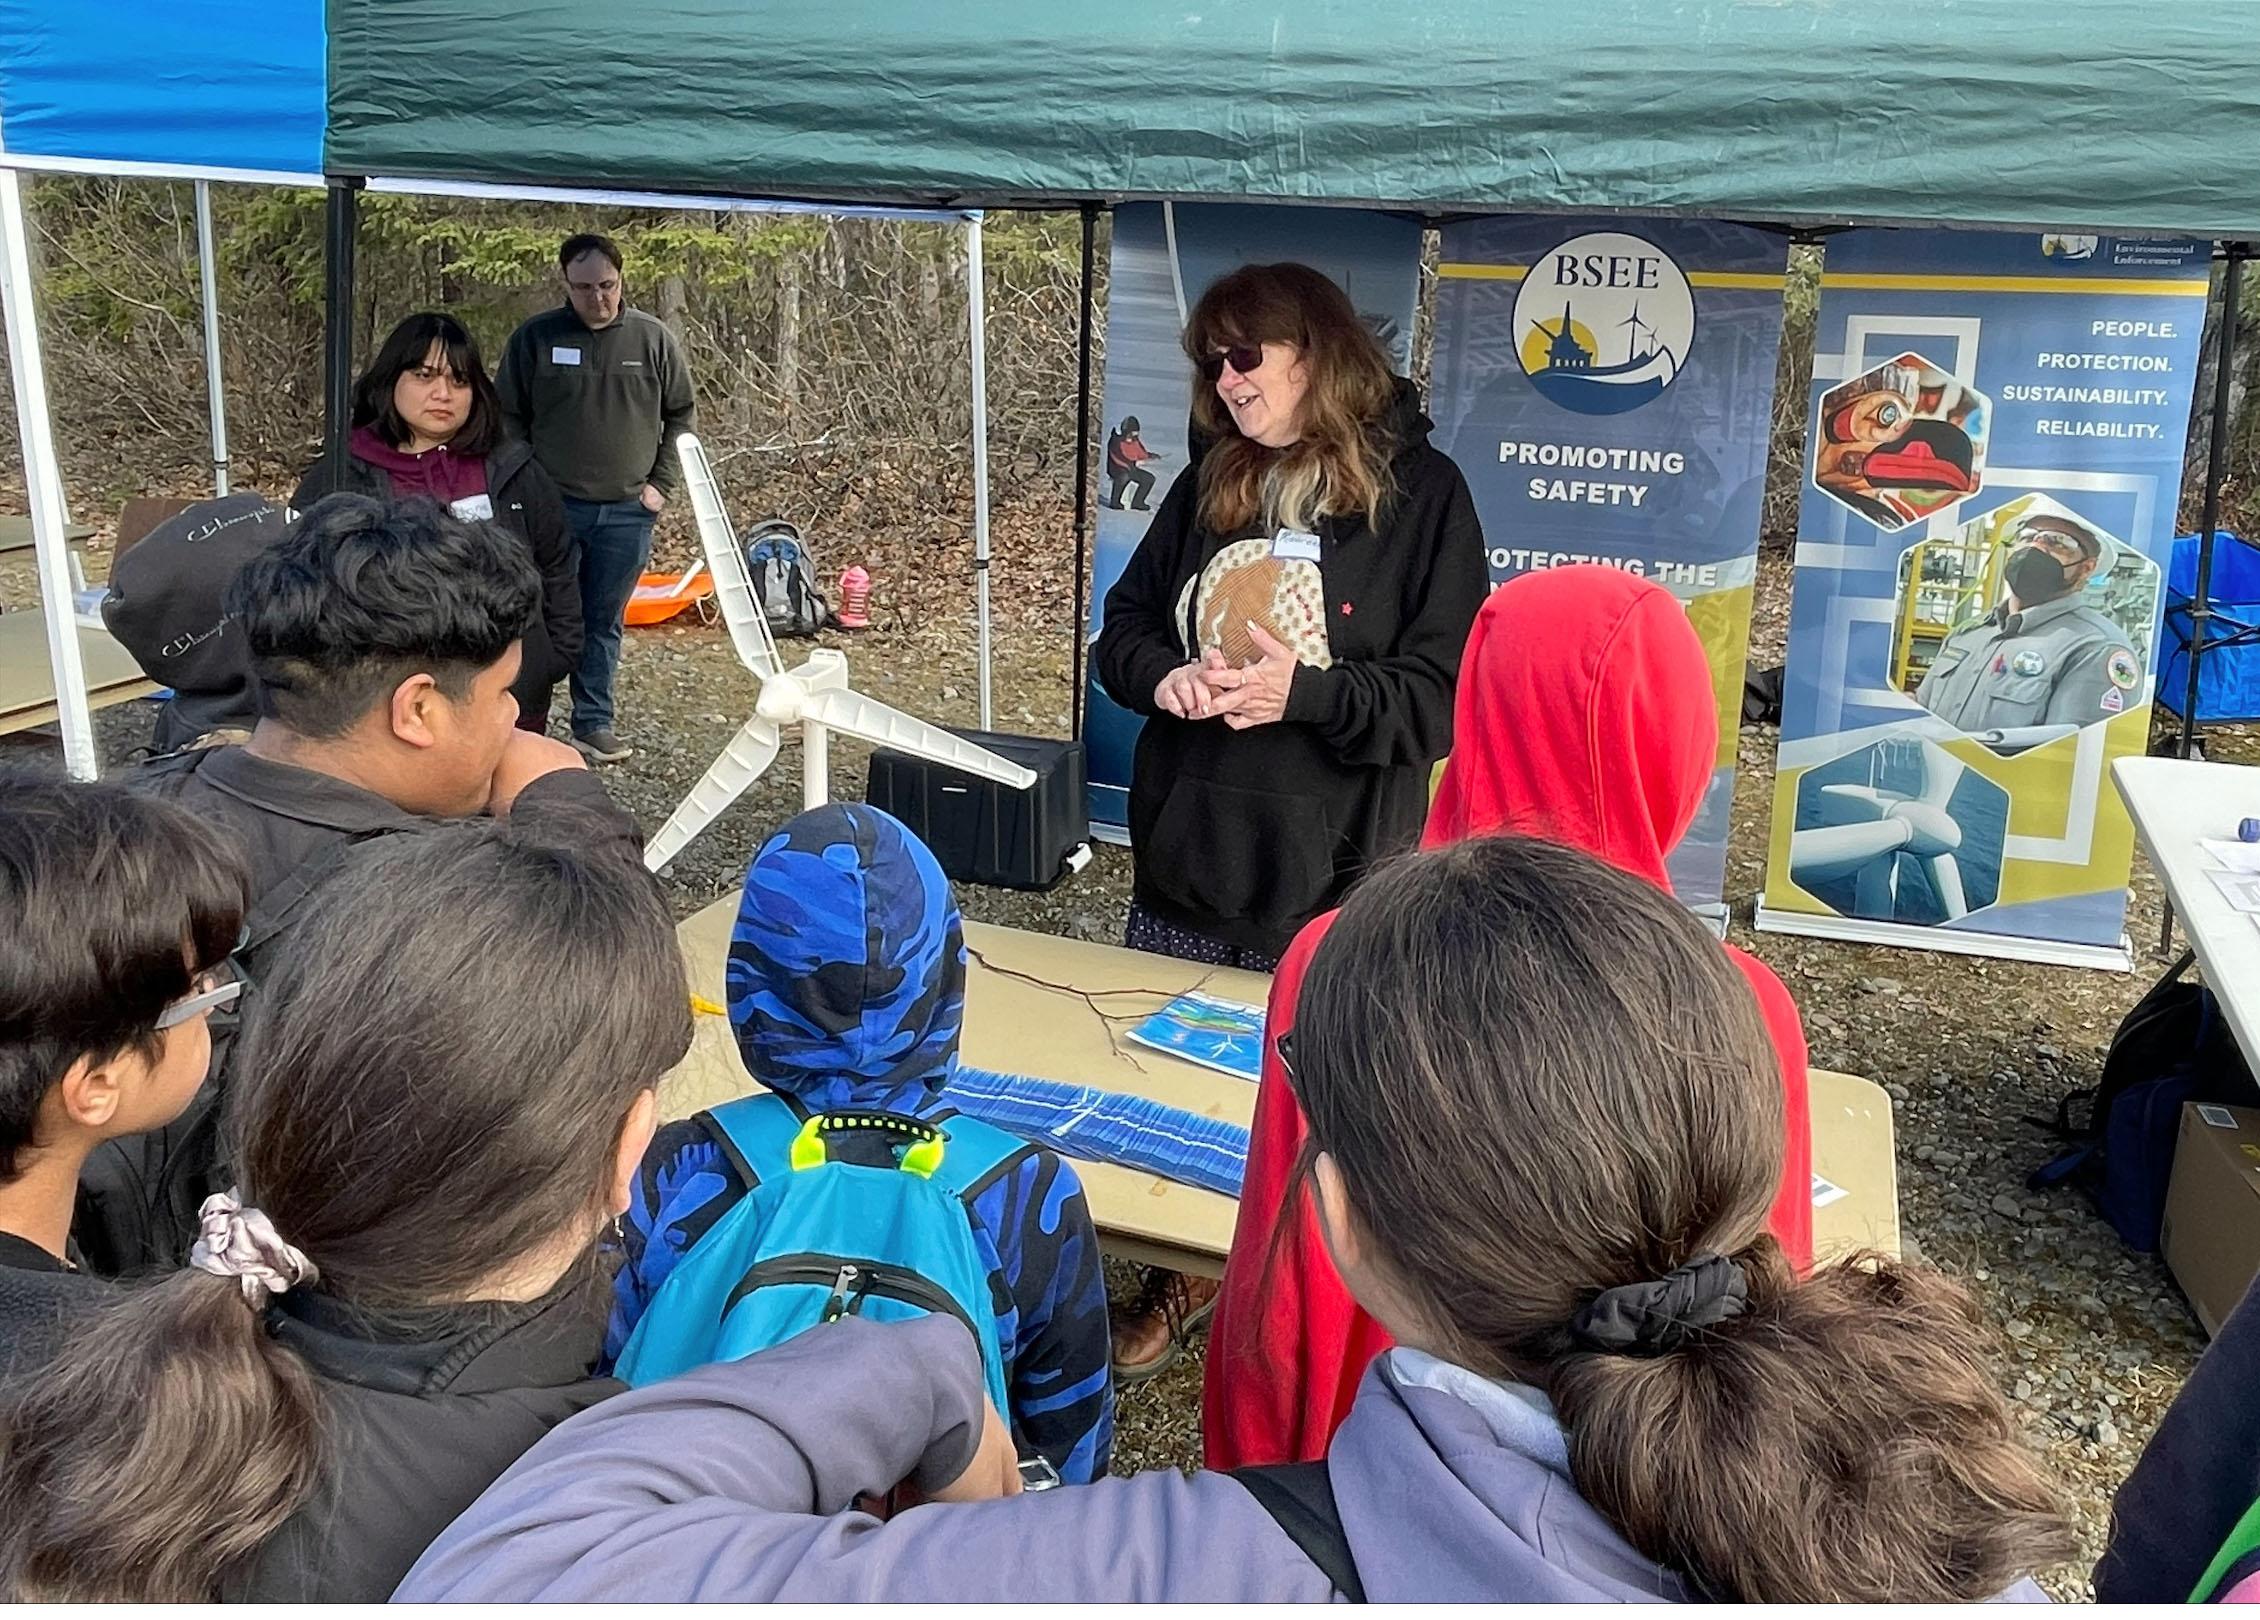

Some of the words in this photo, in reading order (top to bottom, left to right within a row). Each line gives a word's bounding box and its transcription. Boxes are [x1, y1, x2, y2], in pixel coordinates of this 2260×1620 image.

[1553, 254, 1661, 290] BSEE
[2092, 320, 2178, 339] PEOPLE.
[2037, 352, 2174, 373] PROTECTION.
[2002, 385, 2169, 406] SUSTAINABILITY.
[2036, 419, 2165, 439] RELIABILITY.
[1499, 441, 1685, 475] PROMOTING
[1528, 478, 1649, 508] SAFETY
[1485, 547, 1647, 577] OTECTNG
[1654, 561, 1718, 587] THE
